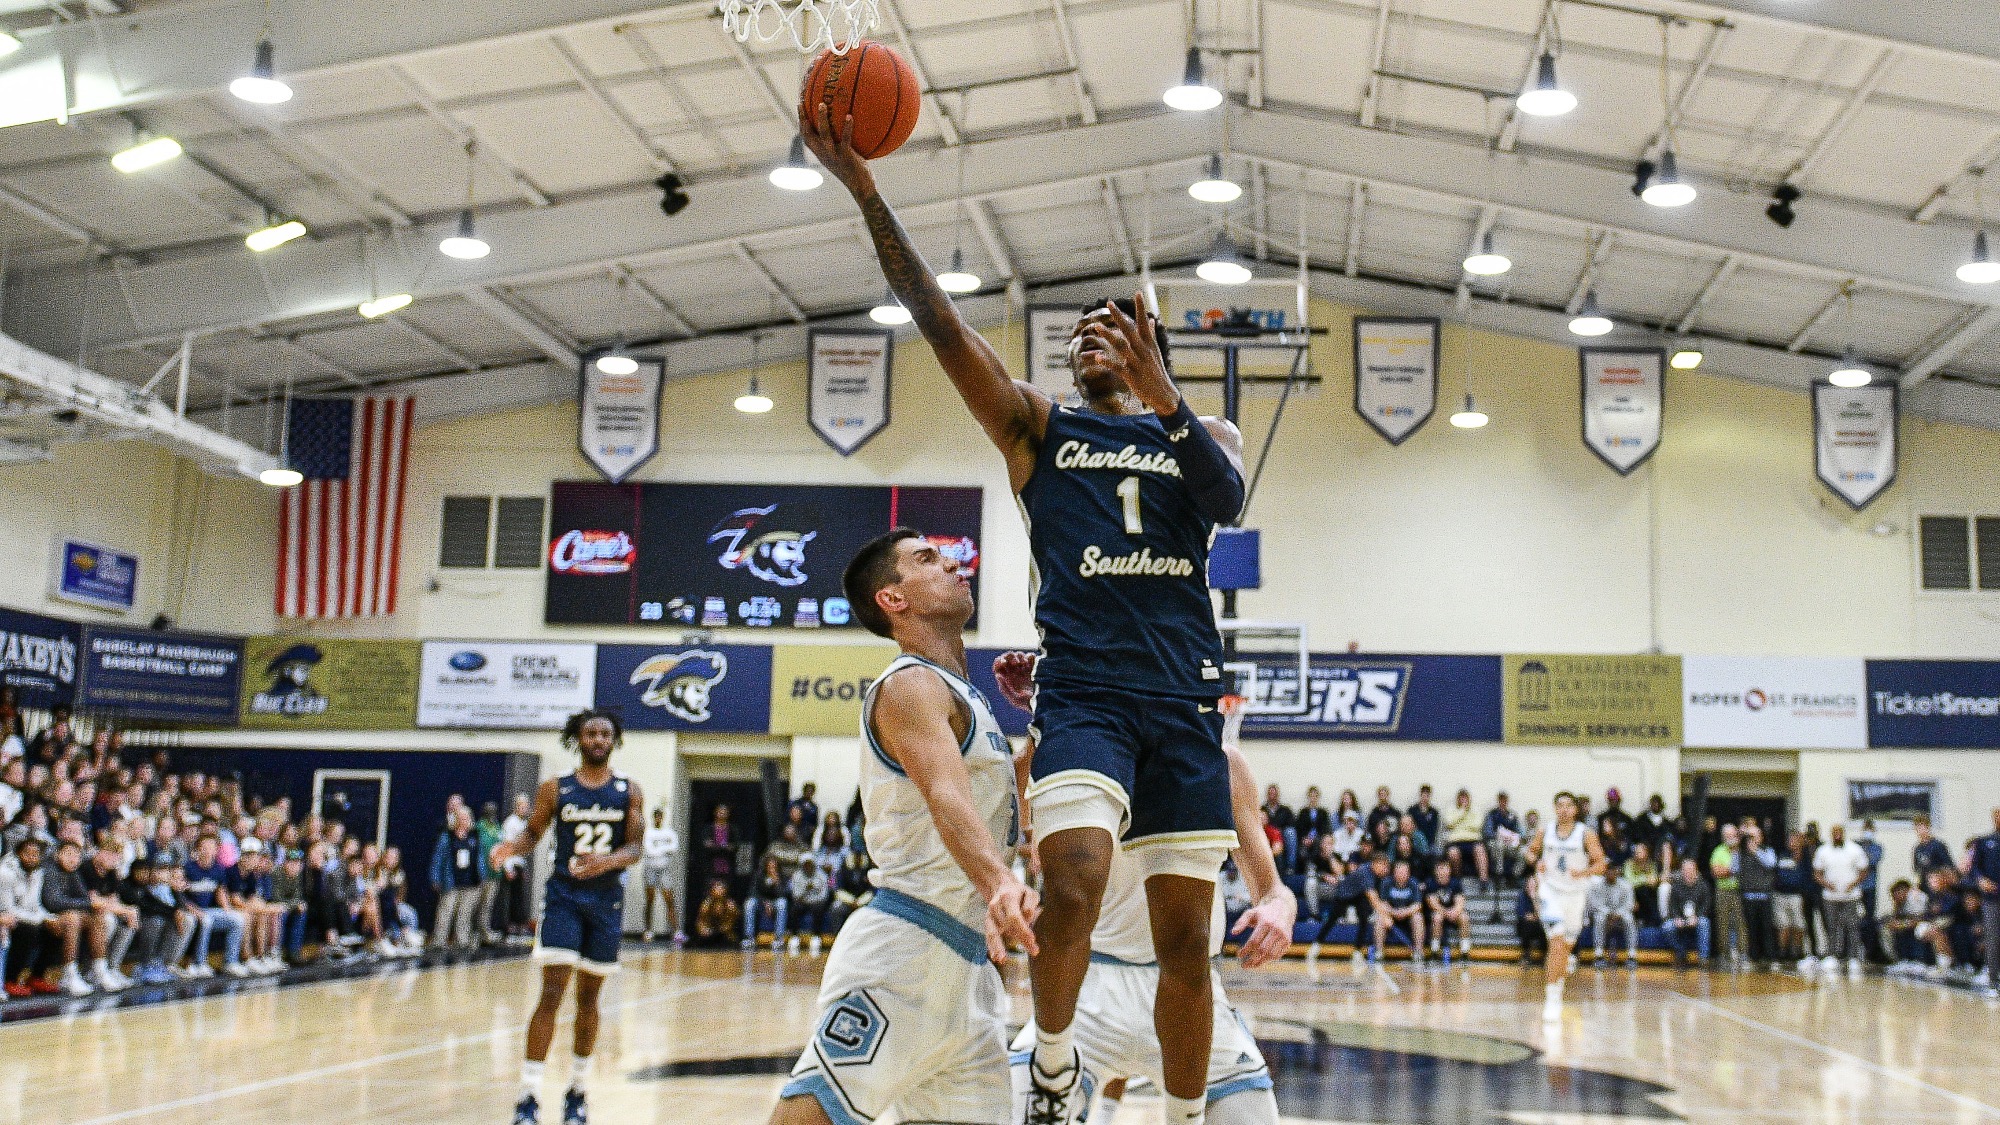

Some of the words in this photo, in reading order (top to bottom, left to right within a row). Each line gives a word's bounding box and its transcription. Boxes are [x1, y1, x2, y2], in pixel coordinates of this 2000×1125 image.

[1184, 308, 1285, 330] SOTH
[1116, 476, 1143, 534] 1
[1079, 545, 1193, 577] Southern
[573, 822, 613, 855] 22
